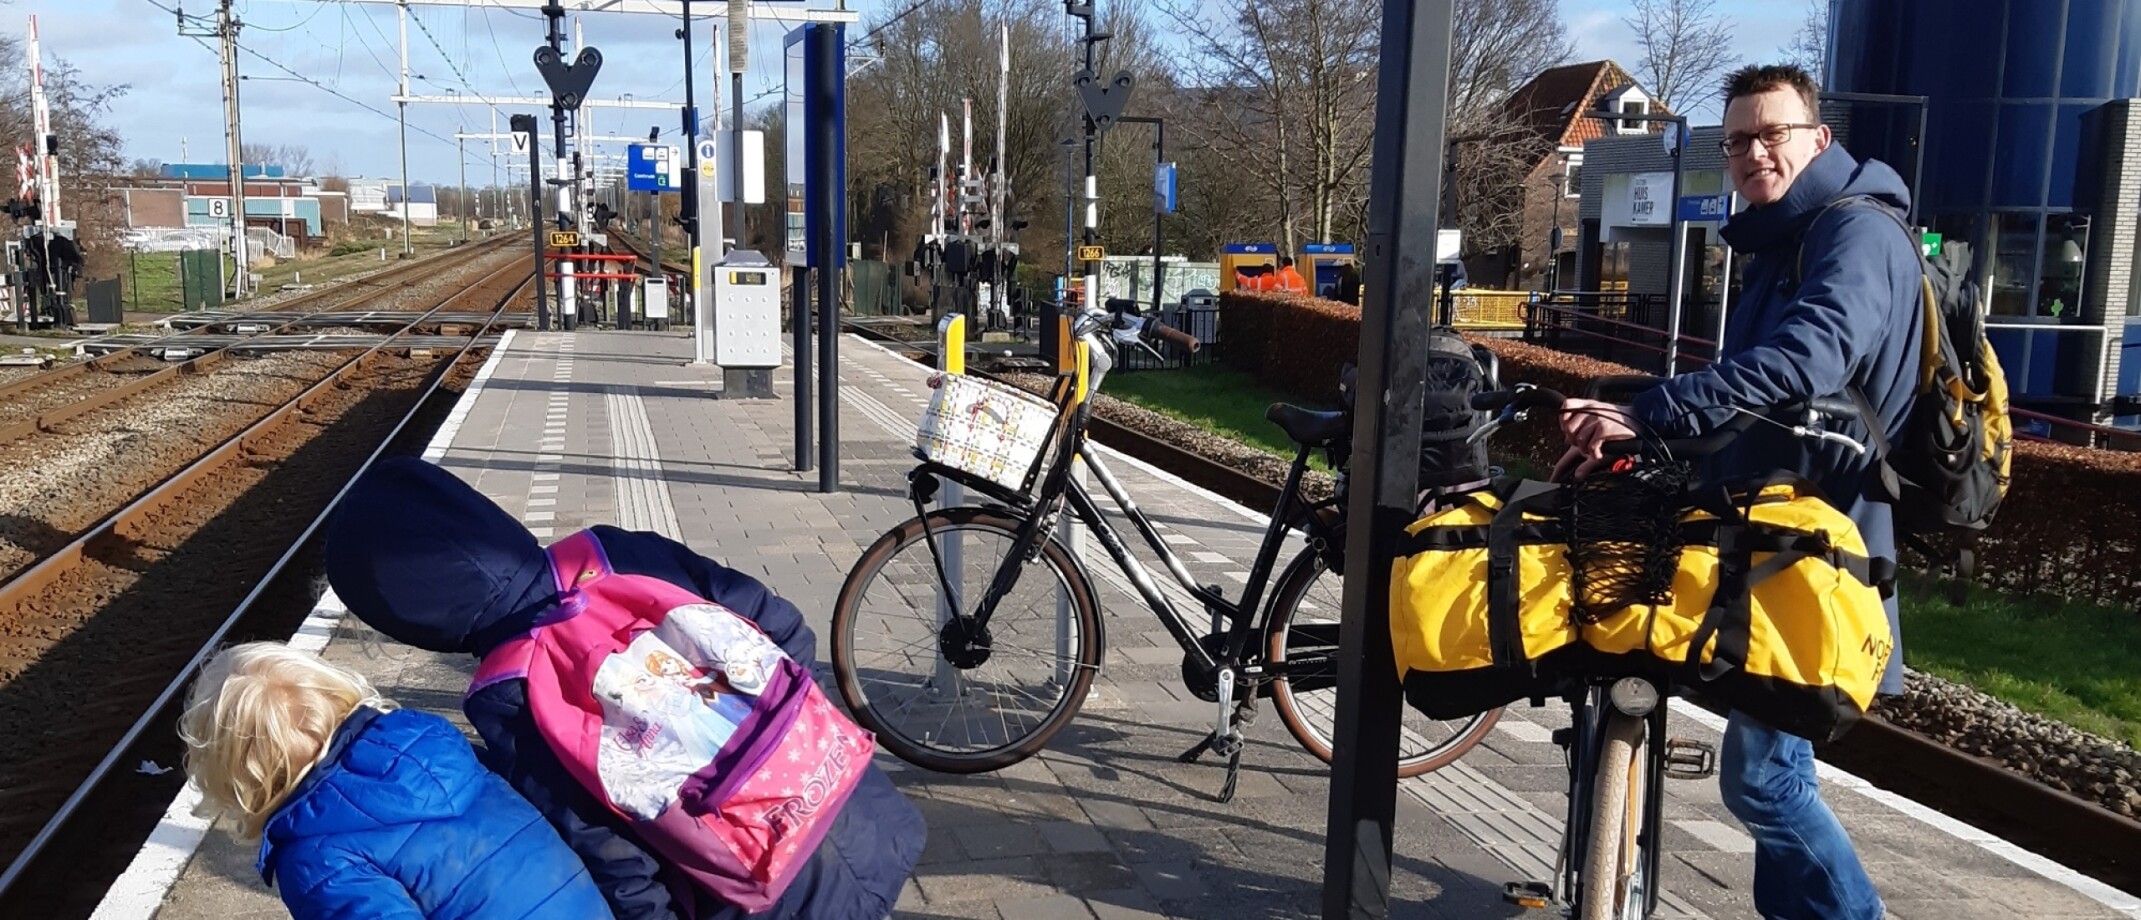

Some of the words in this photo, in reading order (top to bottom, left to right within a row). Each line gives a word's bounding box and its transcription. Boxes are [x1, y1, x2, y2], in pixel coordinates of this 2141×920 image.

[513, 134, 527, 151] V
[1634, 186, 1648, 200] HUIS
[213, 200, 223, 215] 8
[1632, 200, 1654, 215] KAMER
[554, 233, 575, 244] 1264
[1082, 248, 1100, 258] 1266
